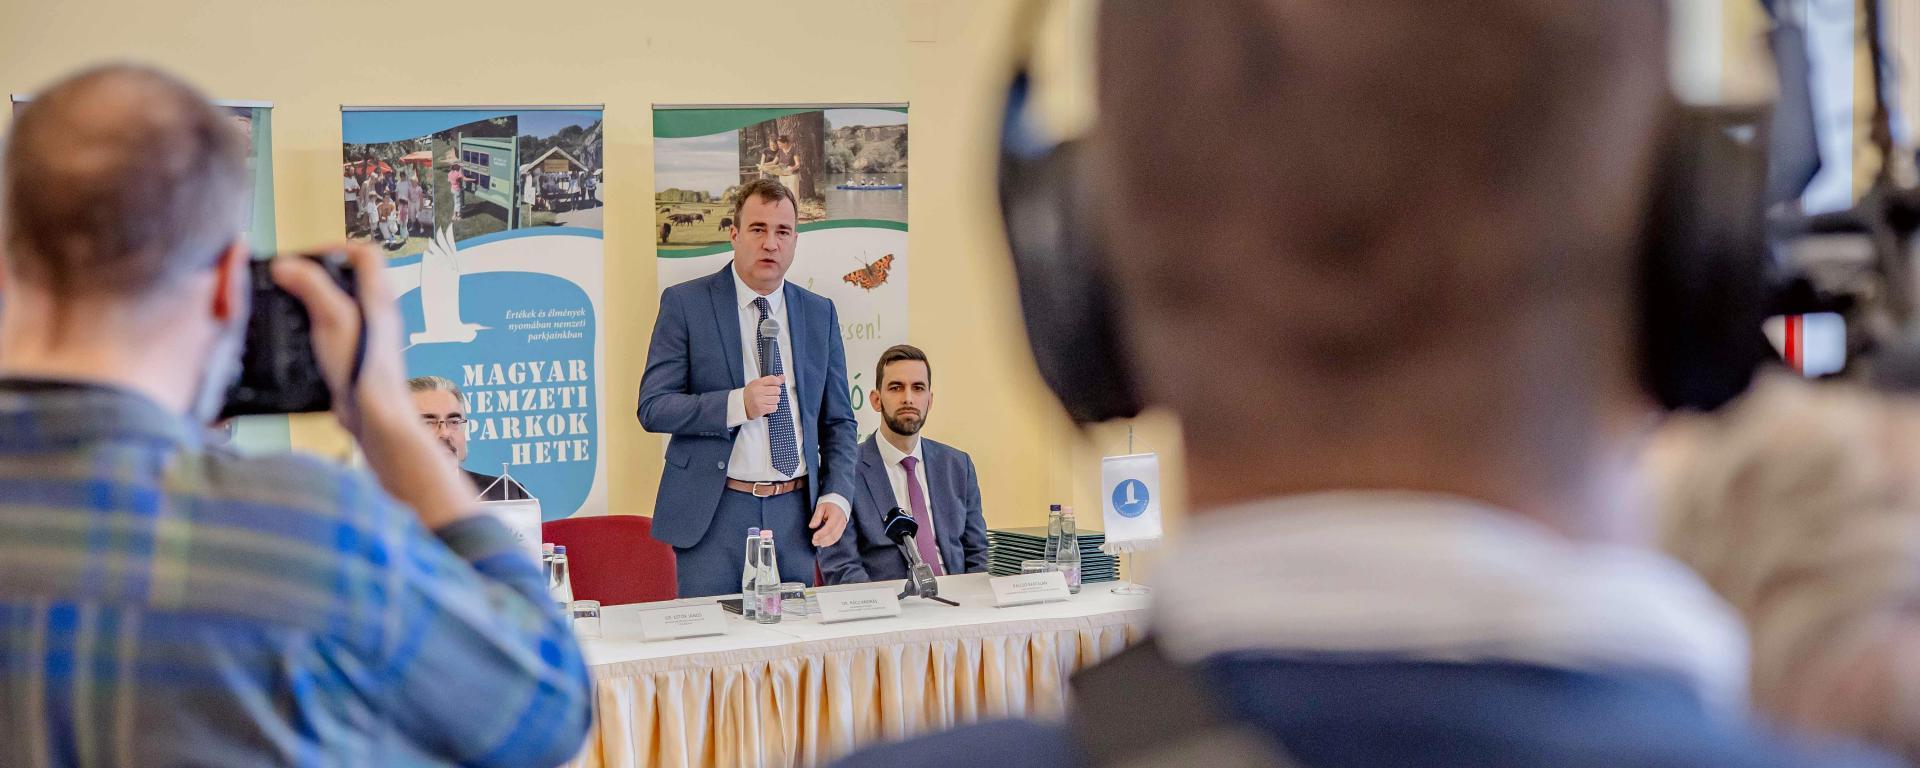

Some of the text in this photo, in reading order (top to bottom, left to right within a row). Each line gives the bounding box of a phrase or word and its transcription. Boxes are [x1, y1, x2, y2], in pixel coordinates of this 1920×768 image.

[506, 307, 586, 320] Értékek és élmények
[508, 319, 586, 333] nyomában nemzeti
[527, 330, 583, 343] parkjainkban
[462, 359, 588, 387] MAGYAR
[462, 386, 588, 414] NEMZETI
[465, 413, 589, 441] PARKOK
[511, 439, 589, 466] HETE
